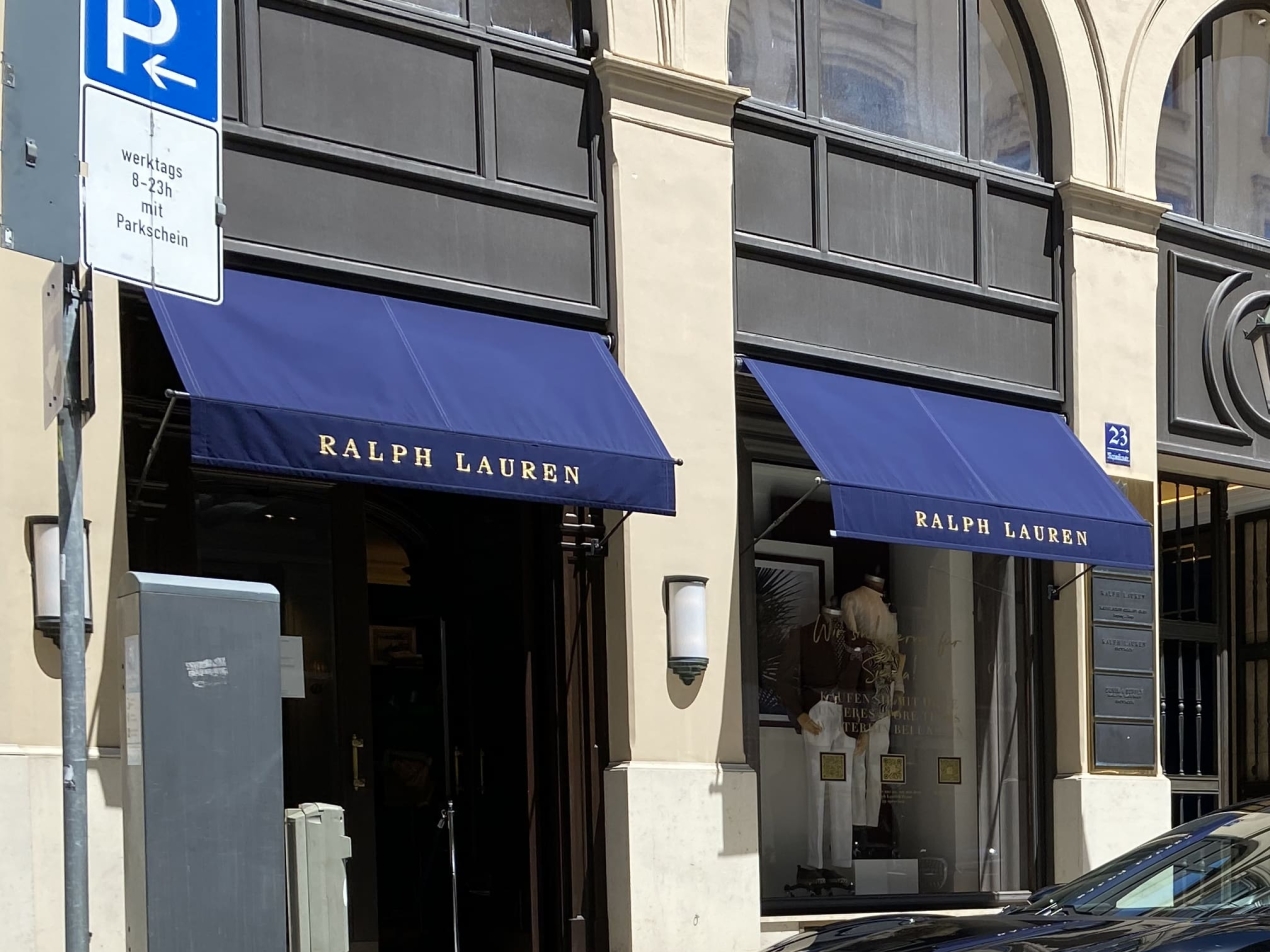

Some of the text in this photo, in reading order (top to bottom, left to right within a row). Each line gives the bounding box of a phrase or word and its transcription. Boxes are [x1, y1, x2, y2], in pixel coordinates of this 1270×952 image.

[121, 148, 183, 179] werktags
[131, 172, 173, 198] 8-23h
[141, 201, 164, 218] mit
[116, 213, 189, 248] Parkschein
[1109, 426, 1128, 446] 23
[318, 434, 580, 485] RALPH LAUREN
[914, 510, 1088, 547] RALPH LAUREN
